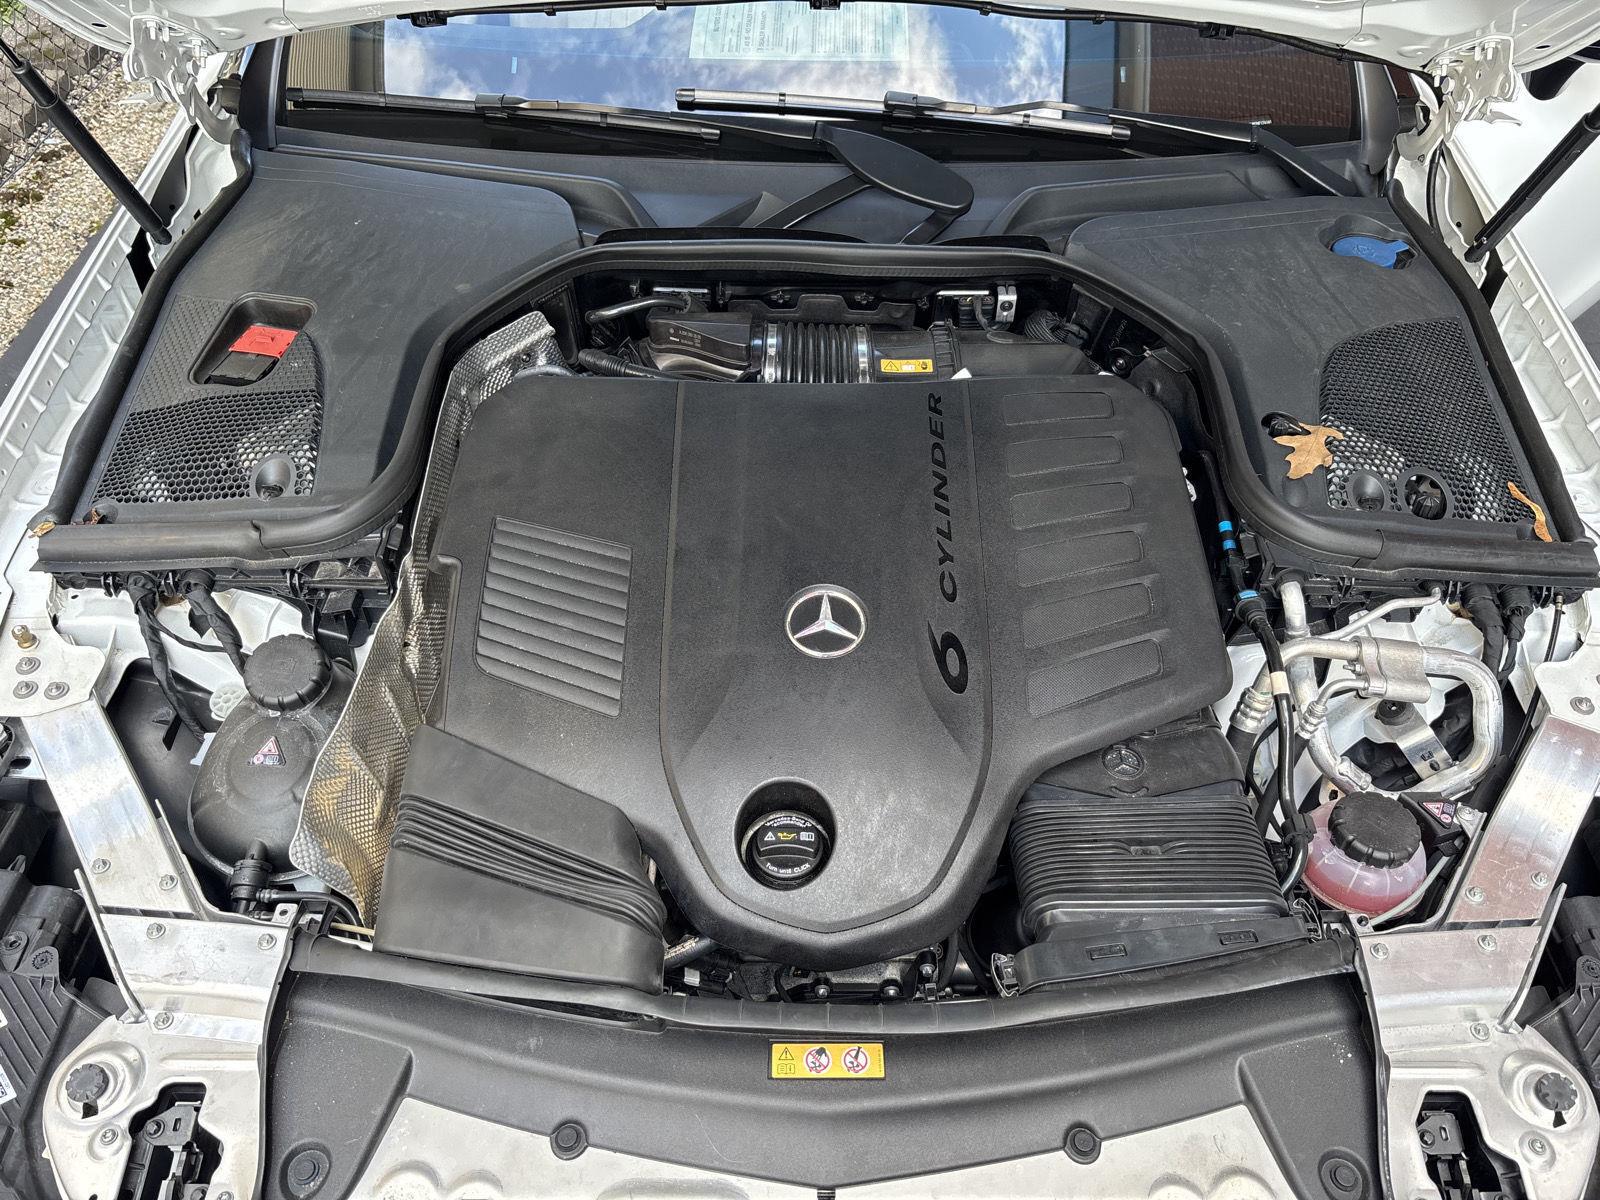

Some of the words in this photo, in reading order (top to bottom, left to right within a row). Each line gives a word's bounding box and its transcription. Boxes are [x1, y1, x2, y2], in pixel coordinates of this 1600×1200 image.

[928, 392, 958, 603] CYLINDER
[928, 620, 968, 694] 6
[766, 862, 777, 871] Turn
[793, 862, 811, 873] CLICK
